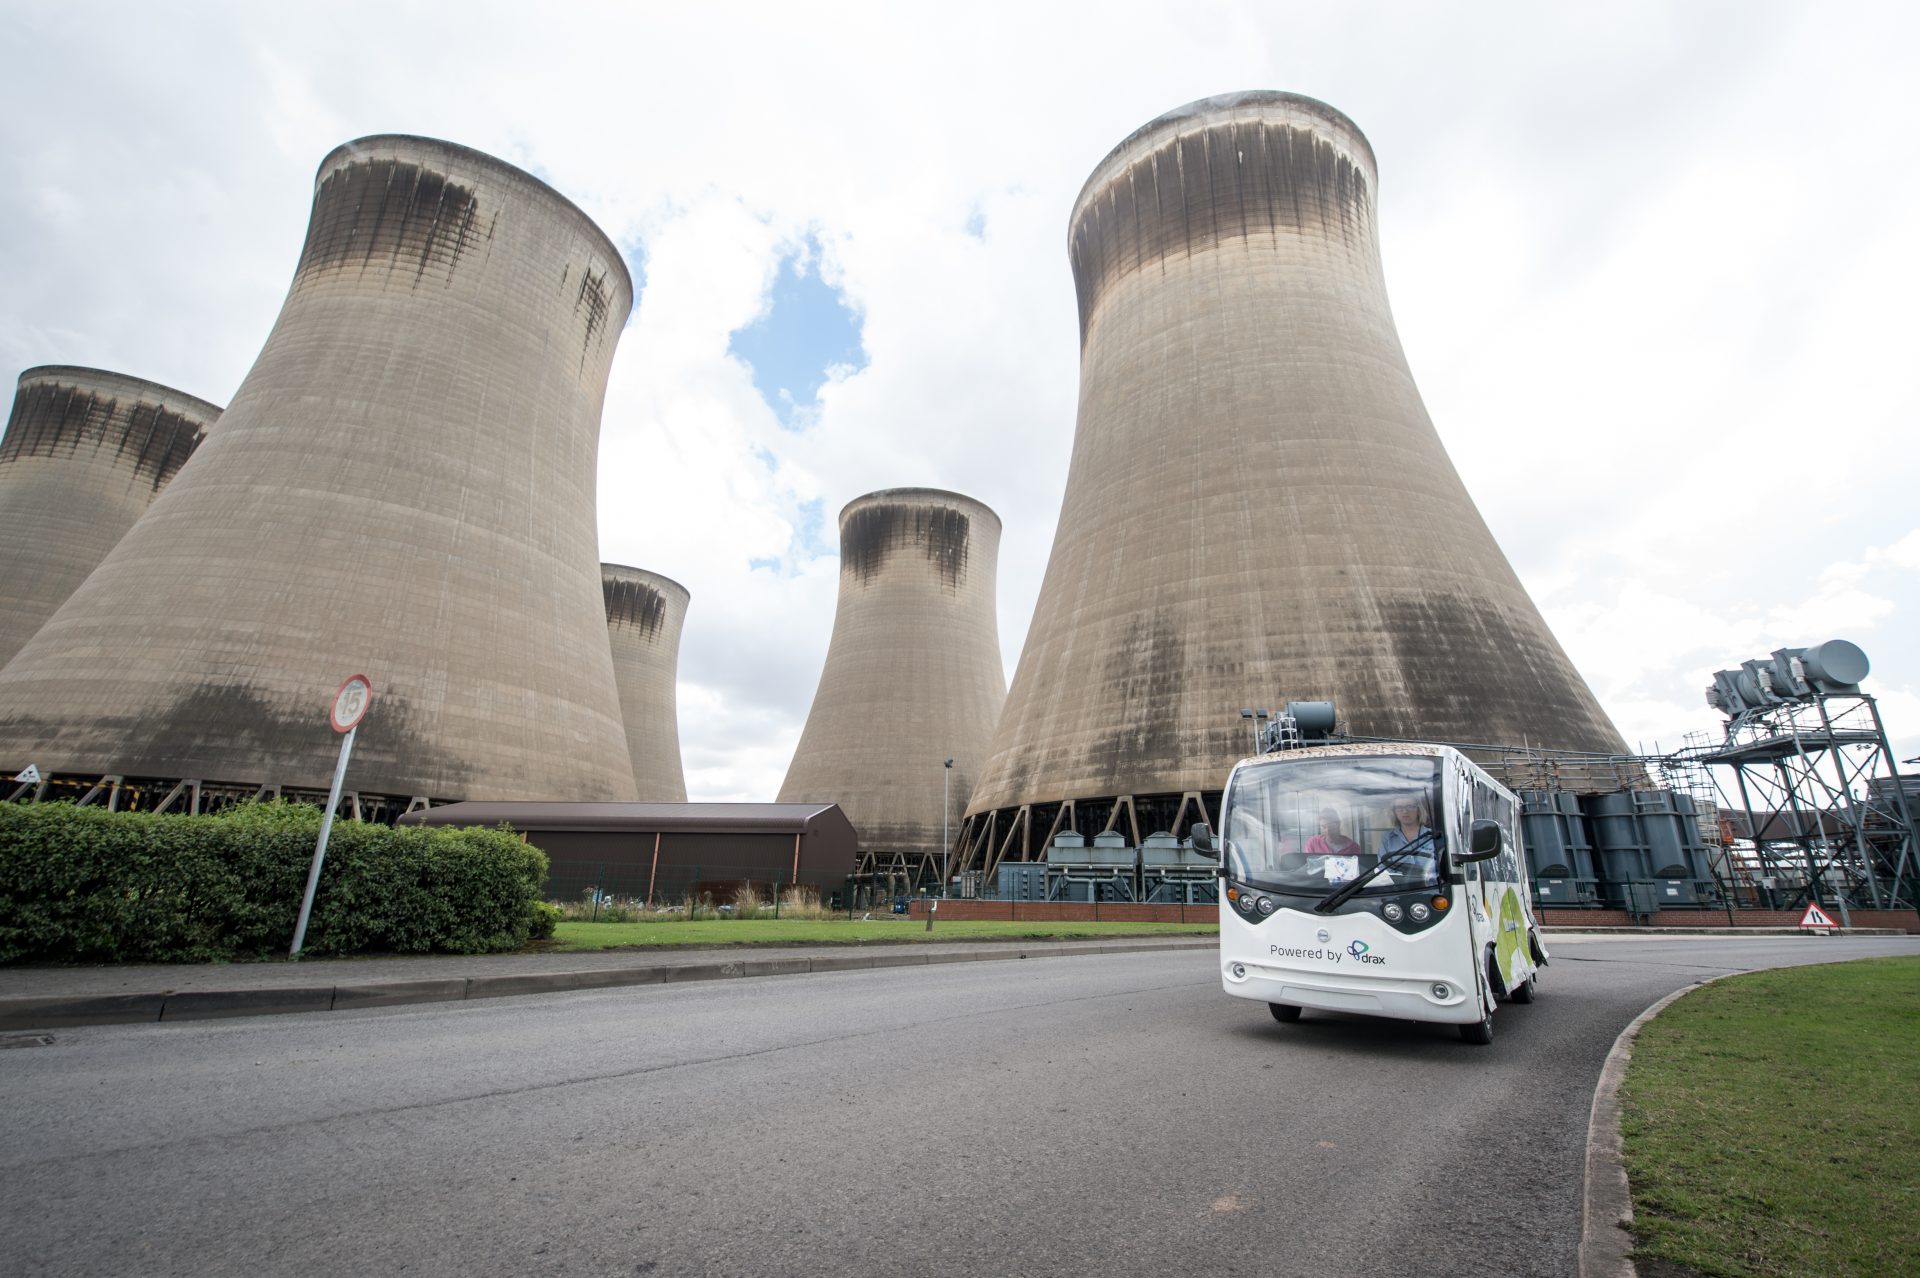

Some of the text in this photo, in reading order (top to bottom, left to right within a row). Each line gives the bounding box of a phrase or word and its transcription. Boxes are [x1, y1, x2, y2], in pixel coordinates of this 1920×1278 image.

[1270, 945, 1386, 965] Powered by drax
